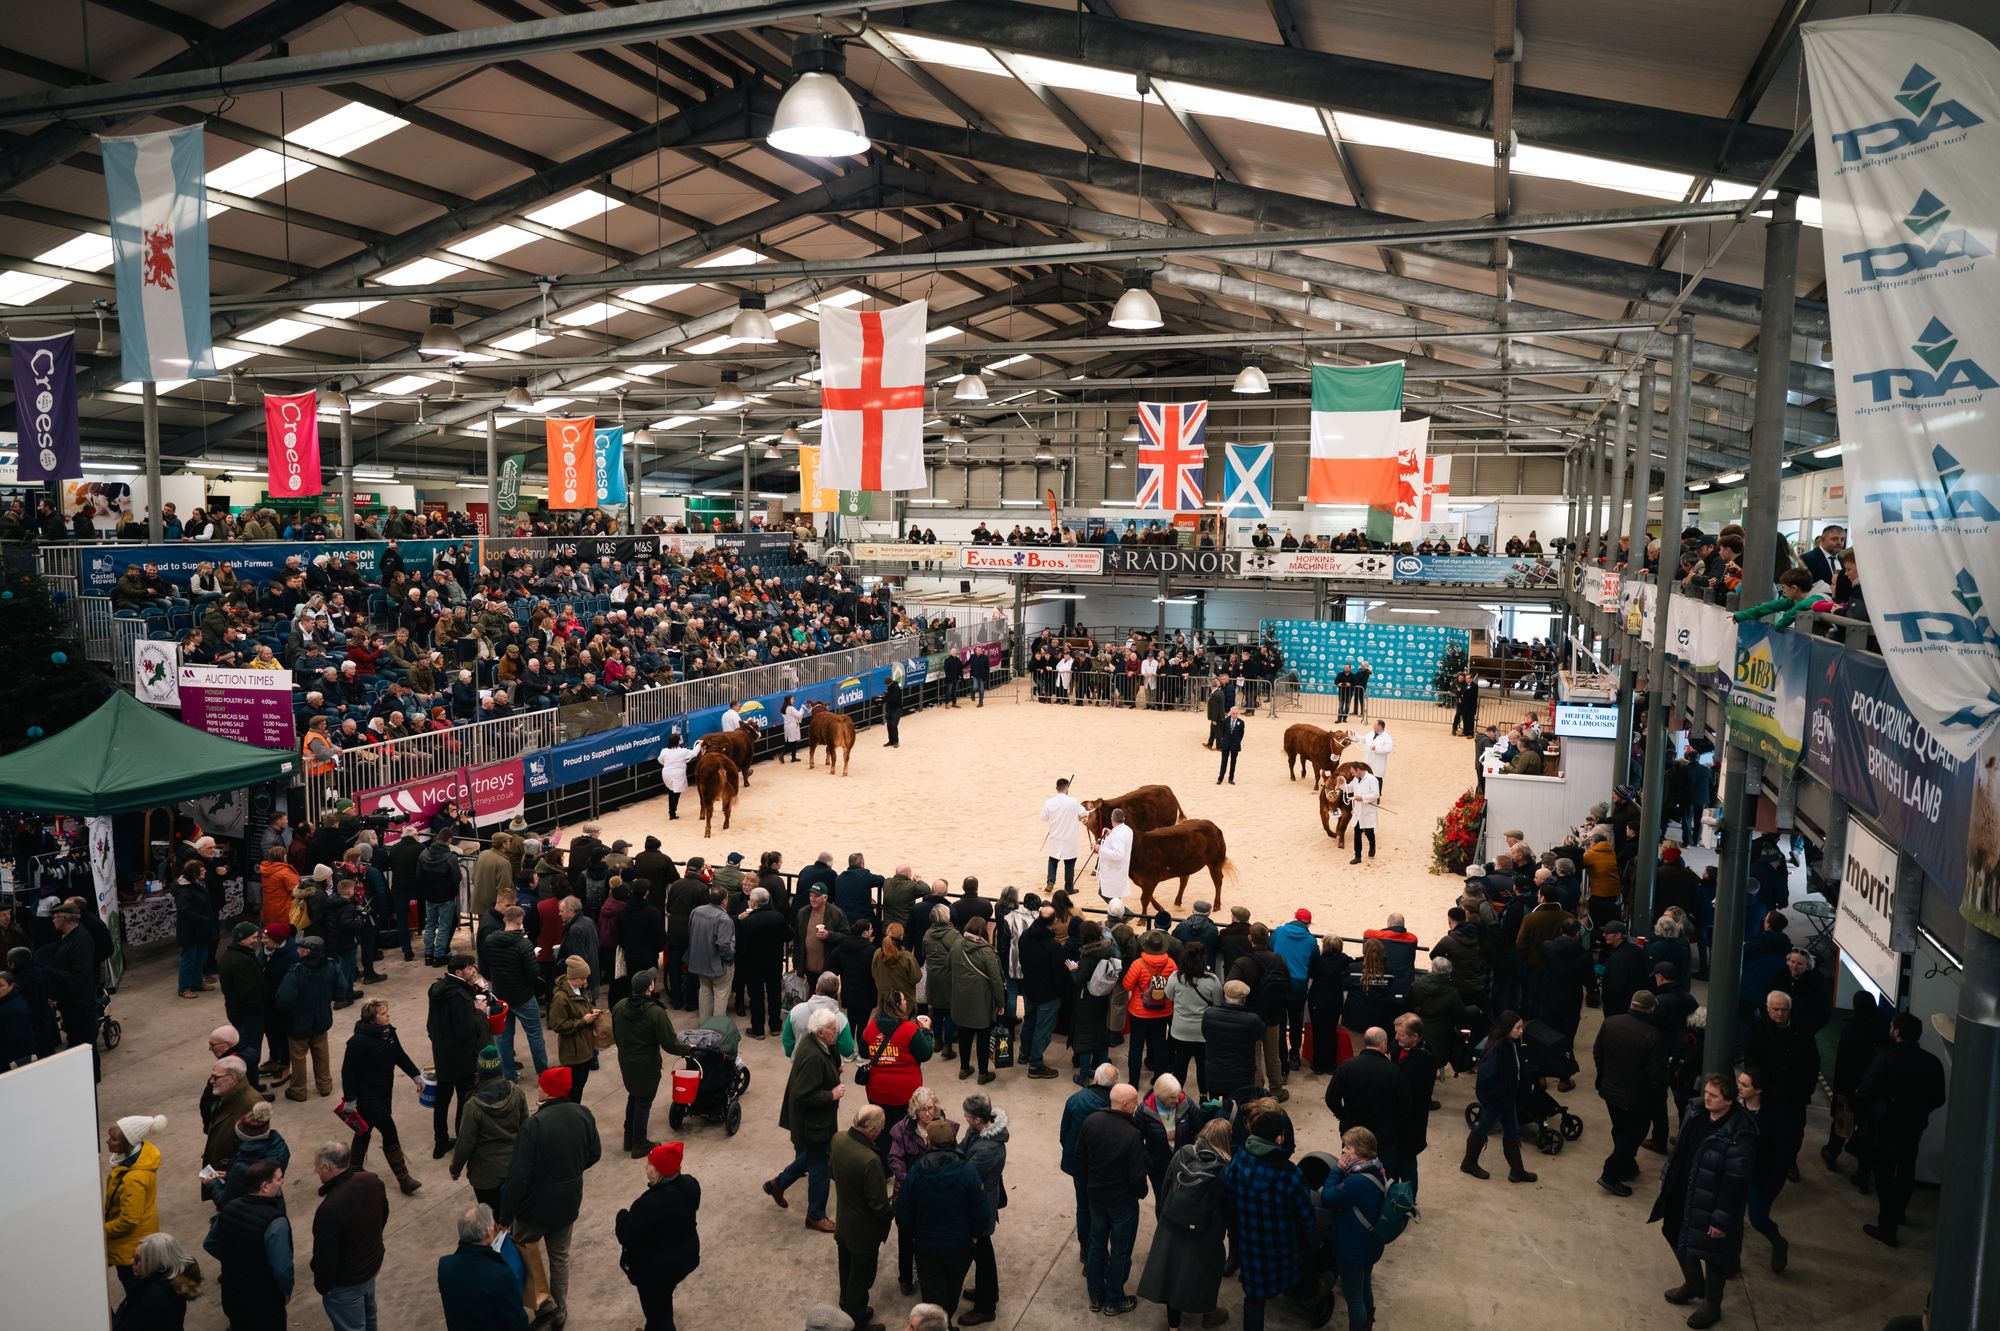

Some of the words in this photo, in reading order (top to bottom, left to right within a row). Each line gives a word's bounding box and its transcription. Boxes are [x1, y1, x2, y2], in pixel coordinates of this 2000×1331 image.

[597, 542, 617, 555] M&S
[634, 541, 653, 553] M&S
[967, 551, 1013, 567] Evans
[1027, 552, 1069, 568] Bros.
[1126, 550, 1238, 573] RADNOR
[1296, 555, 1335, 563] HOPKINS
[171, 562, 180, 571] to
[244, 560, 274, 568] Farmers
[1289, 562, 1342, 571] MACHINERY
[1400, 561, 1419, 570] NSA
[93, 577, 117, 585] Howell
[205, 674, 247, 685] AUCTION
[248, 675, 275, 686] TIMES
[837, 688, 864, 706] dunbia
[1564, 712, 1593, 720] HEIFER,
[1851, 690, 1913, 749] PROCURING
[1578, 720, 1615, 728] LIMOUSIN
[563, 755, 582, 767] Proud
[583, 754, 590, 762] to
[591, 747, 615, 760] Support
[615, 742, 632, 753] Welsh
[632, 735, 661, 749] Producers
[1868, 745, 1902, 799] BRITISH
[1903, 770, 1943, 823] LAMB
[1841, 900, 1858, 921] Livestock
[1857, 918, 1874, 942] Handling
[1873, 932, 1895, 961] Equipment
